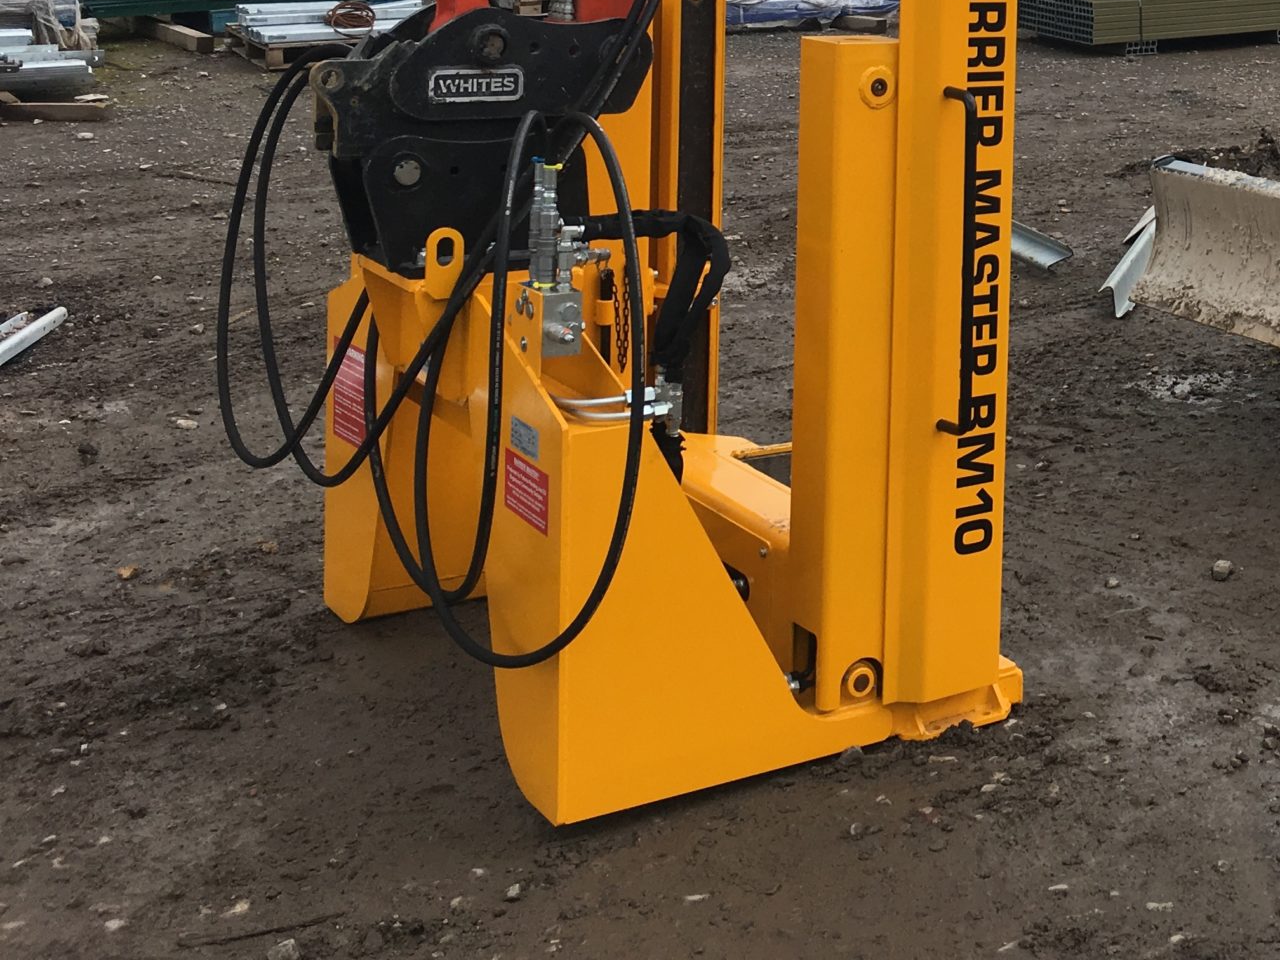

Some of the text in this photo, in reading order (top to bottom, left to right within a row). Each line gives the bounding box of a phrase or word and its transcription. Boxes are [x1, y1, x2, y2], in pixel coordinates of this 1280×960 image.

[439, 77, 515, 93] WHITES
[961, 170, 1002, 376] MASTER
[954, 393, 997, 556] BM10
